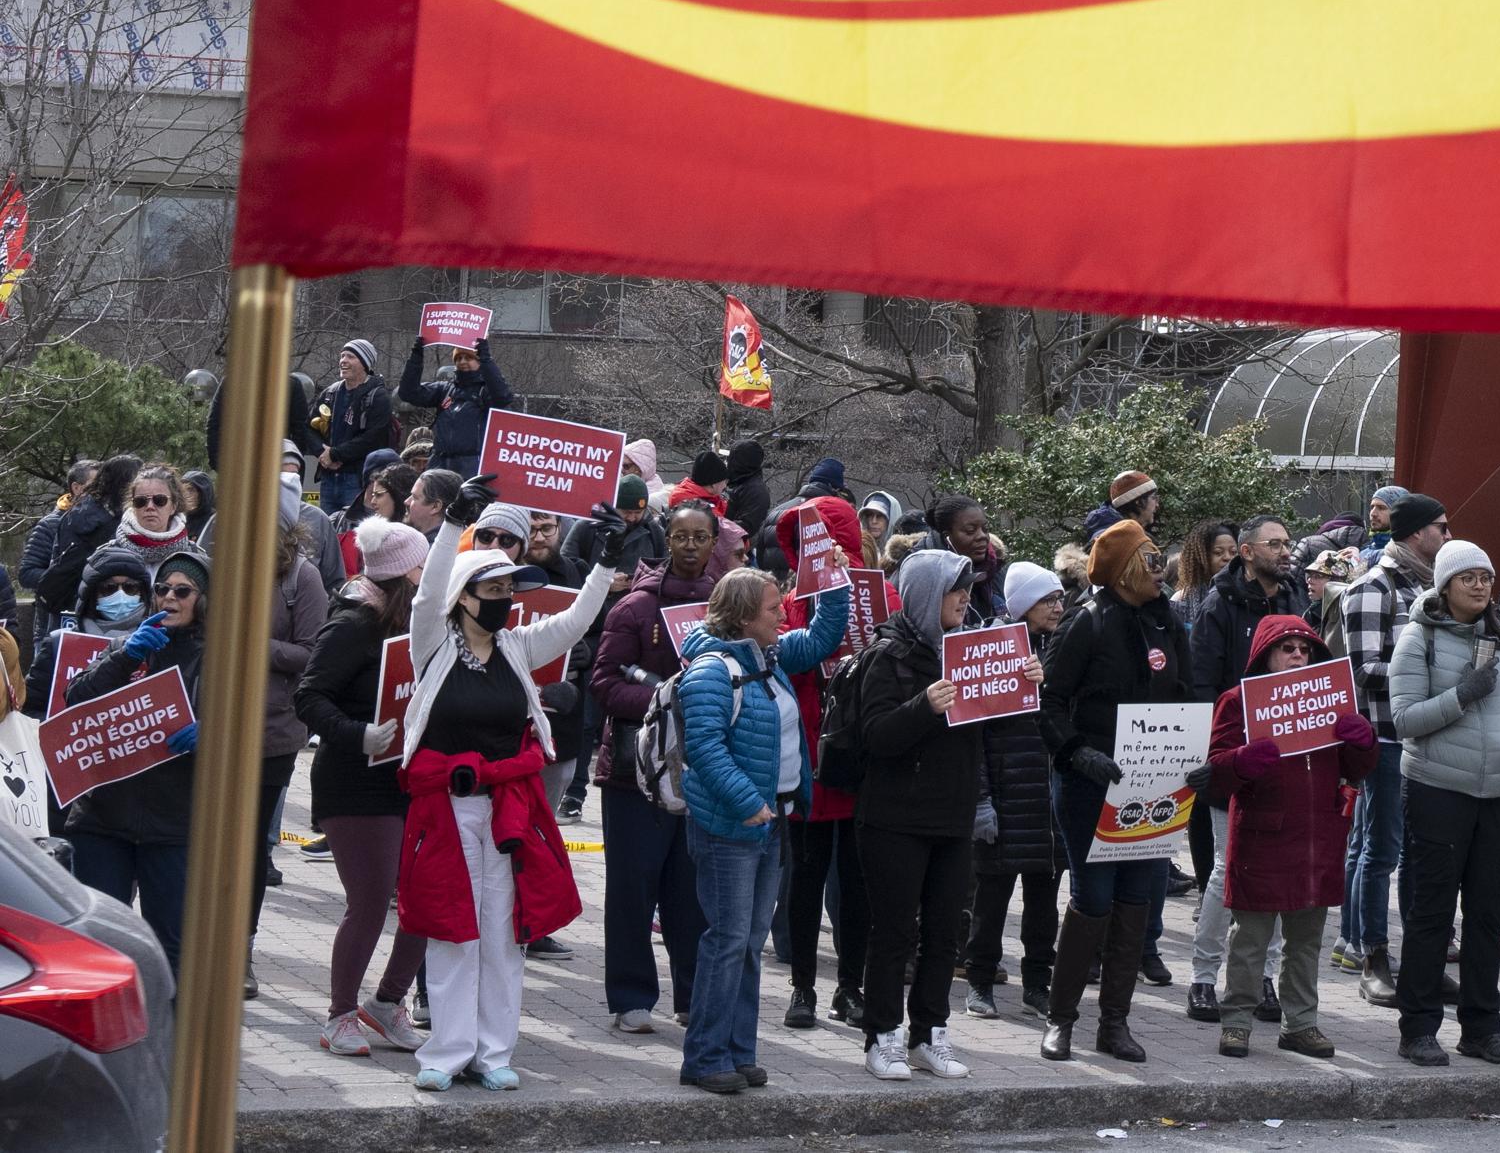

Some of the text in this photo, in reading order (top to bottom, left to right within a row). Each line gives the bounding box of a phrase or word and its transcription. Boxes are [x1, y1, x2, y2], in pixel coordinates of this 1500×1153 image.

[426, 310, 485, 323] I SUPPORT MY
[426, 318, 480, 331] BARGAINING
[438, 326, 463, 336] TEAM
[497, 430, 613, 463] I SUPPORT MY
[498, 448, 605, 480] BARGAINING
[526, 471, 573, 493] TEAM
[962, 639, 1016, 661] J'APPUIE
[951, 667, 981, 683] MON
[962, 677, 1019, 700] DE NÉGO
[1270, 676, 1332, 701] J'APPUIE
[69, 694, 153, 736] J'APPUIE
[1255, 690, 1348, 722] MON ÉQUIPE
[55, 703, 179, 764] MON ÉQUIPE
[1272, 711, 1337, 737] DE NÉGO
[77, 730, 166, 771] DE NÉGO
[1123, 741, 1157, 752] même
[1119, 755, 1202, 768] chat est capable
[1131, 770, 1152, 778] faire
[1121, 807, 1173, 819] PSAC AFPC
